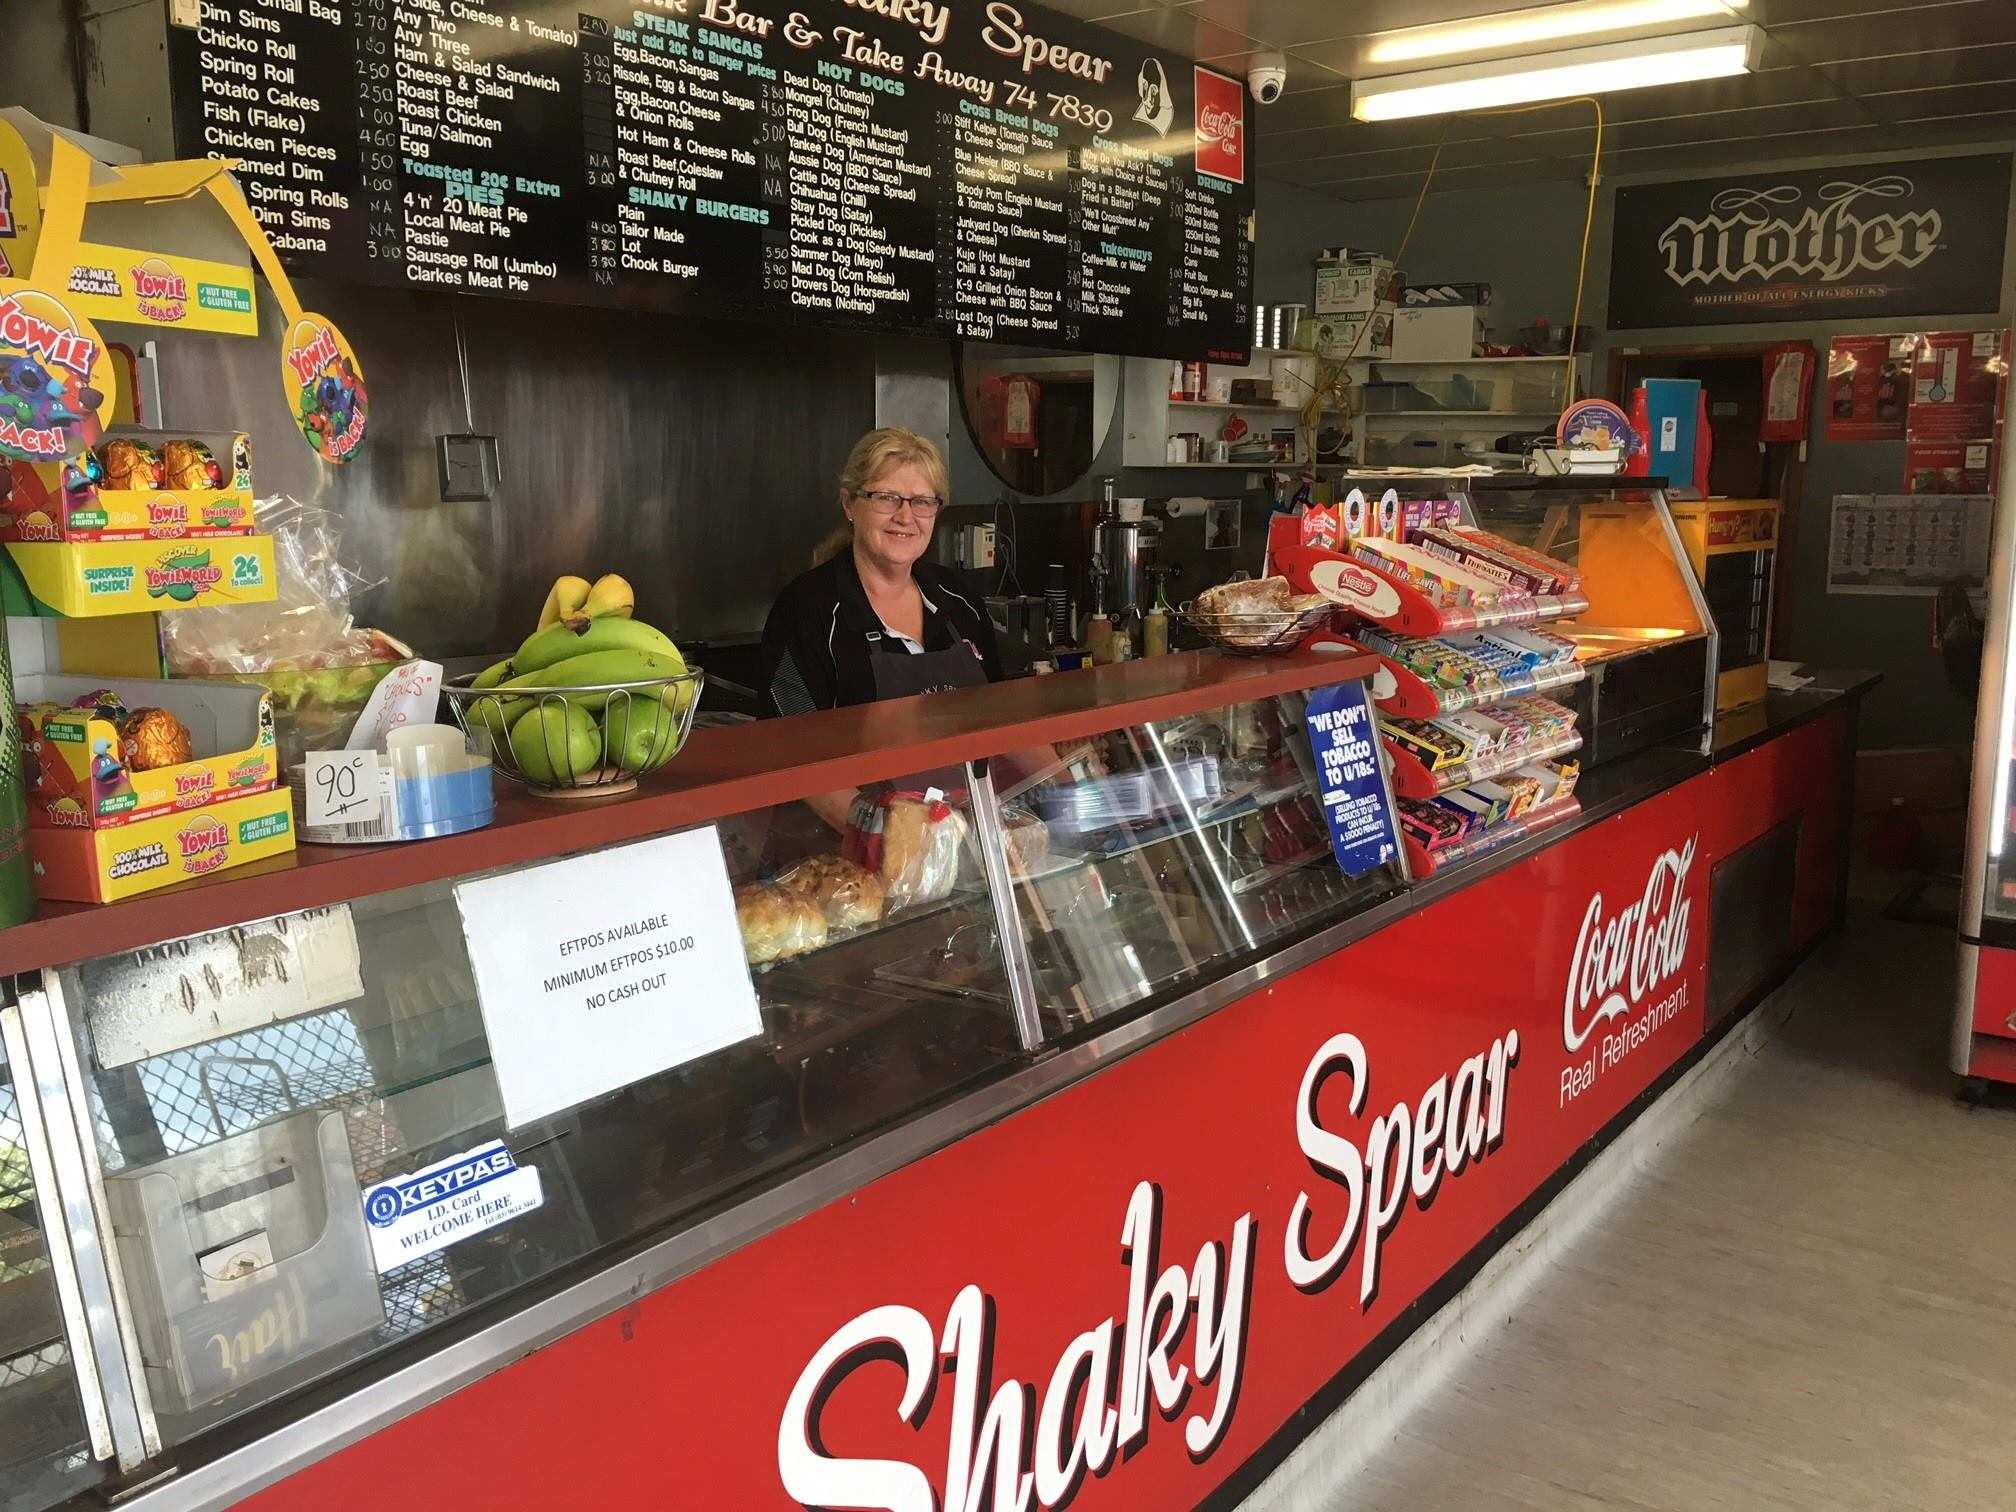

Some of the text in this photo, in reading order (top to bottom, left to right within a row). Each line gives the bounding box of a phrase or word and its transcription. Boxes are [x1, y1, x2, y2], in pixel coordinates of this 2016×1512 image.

[200, 2, 281, 33] Dim Sims
[450, 1, 578, 47] Cheese & Tomato)
[198, 26, 296, 60] Chicko Roll
[394, 25, 470, 55] Any Three
[633, 10, 764, 60] STEAK SANGAS
[981, 2, 1112, 82] Spear
[200, 51, 295, 84] Spring Roll
[394, 43, 560, 93] Ham & Salad Sandwich
[699, 0, 1113, 133] Bar & Take Away 74 7839
[817, 60, 905, 96] HOT DOGS
[202, 76, 320, 112] Potato Cakes
[397, 79, 479, 110] Roast Beef
[783, 70, 874, 106] Dead Dog (Tomato)
[204, 101, 305, 134] Fish (Flake)
[399, 117, 492, 148] Tuna/Salmon
[960, 99, 1059, 137] Cross Breed Dogs
[204, 127, 336, 160] Chicken Pieces
[400, 136, 429, 158] Egg
[618, 147, 648, 166] Roast
[403, 158, 473, 184] Toasted
[515, 176, 561, 198] Extra
[445, 180, 505, 206] PIES
[1197, 175, 1233, 194] DRINKS
[250, 182, 349, 209] Spring Rolls
[404, 192, 414, 208] 4
[443, 197, 462, 214] 20
[468, 201, 502, 219] Meat
[508, 207, 528, 223] Pie
[628, 187, 770, 225] SHAKY BURGERS
[251, 206, 331, 230] Dim Sims
[618, 204, 645, 221] Plain
[264, 230, 326, 252] Cabana
[405, 227, 448, 248] Pastie
[619, 220, 685, 244] Tailor Made
[622, 238, 642, 253] Lot
[406, 245, 557, 278] Sausage Roll (Jumbo)
[621, 254, 699, 278] Chook Burger
[1100, 241, 1153, 262] Takeaways
[406, 264, 529, 291] Clarkes Meat Pie
[1081, 278, 1131, 295] Hot Chocolate
[791, 291, 875, 315] Claytons (Nothing)
[1082, 303, 1124, 318] Thick Shake
[1098, 293, 1119, 305] Shake
[0, 417, 66, 455] ACK!
[84, 566, 135, 581] SURPRISE
[1335, 704, 1367, 725] DON'T
[1331, 726, 1356, 747] SELL
[1322, 740, 1371, 769] TOBACCO
[1325, 766, 1343, 787] TO
[559, 914, 669, 957] EFTPOS AVAILABLE
[543, 935, 694, 993] MINIMUM EFTPOS $10.00
[586, 973, 667, 1011] NO CASH OUT
[1560, 1046, 1596, 1108] Real
[427, 1190, 481, 1221] I.D. Card
[400, 1212, 474, 1249] WELCOME
[476, 1194, 512, 1219] HERE
[777, 1027, 1519, 1512] Shaky Spear
